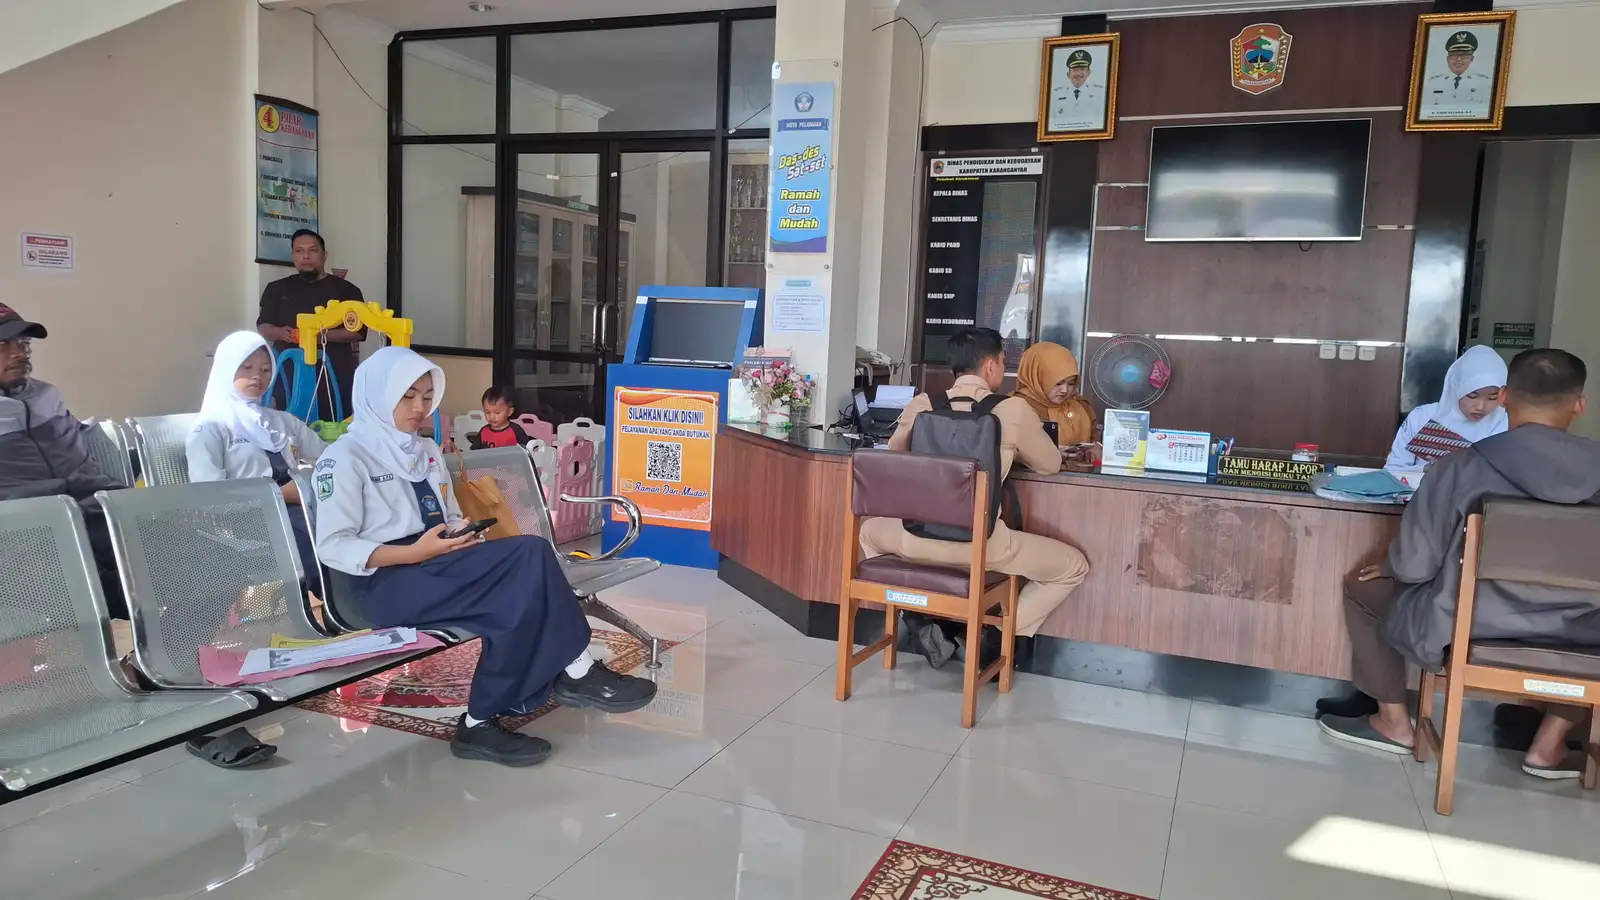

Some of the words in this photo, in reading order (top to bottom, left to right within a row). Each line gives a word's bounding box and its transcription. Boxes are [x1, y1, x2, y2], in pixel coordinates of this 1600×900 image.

[263, 106, 274, 129] 4
[280, 111, 303, 126] PILAR
[787, 153, 827, 180] Sat-set
[780, 188, 821, 200] Ramah
[788, 203, 811, 215] dan
[779, 217, 819, 229] Mudah
[629, 407, 661, 421] SILAHKAN
[663, 409, 680, 423] KLIK
[622, 425, 649, 434] PELAYANAN
[649, 427, 659, 435] APA
[659, 428, 672, 436] YANG
[672, 429, 686, 437] ANDA
[1223, 467, 1239, 475] DAN
[1240, 469, 1271, 477] MENGISI
[1224, 457, 1250, 470] TAMU
[1252, 459, 1285, 472] HARAP
[1286, 462, 1318, 475] LAPOR
[634, 481, 660, 493] Ramah
[662, 484, 678, 495] Dan
[680, 486, 708, 497] Mudah
